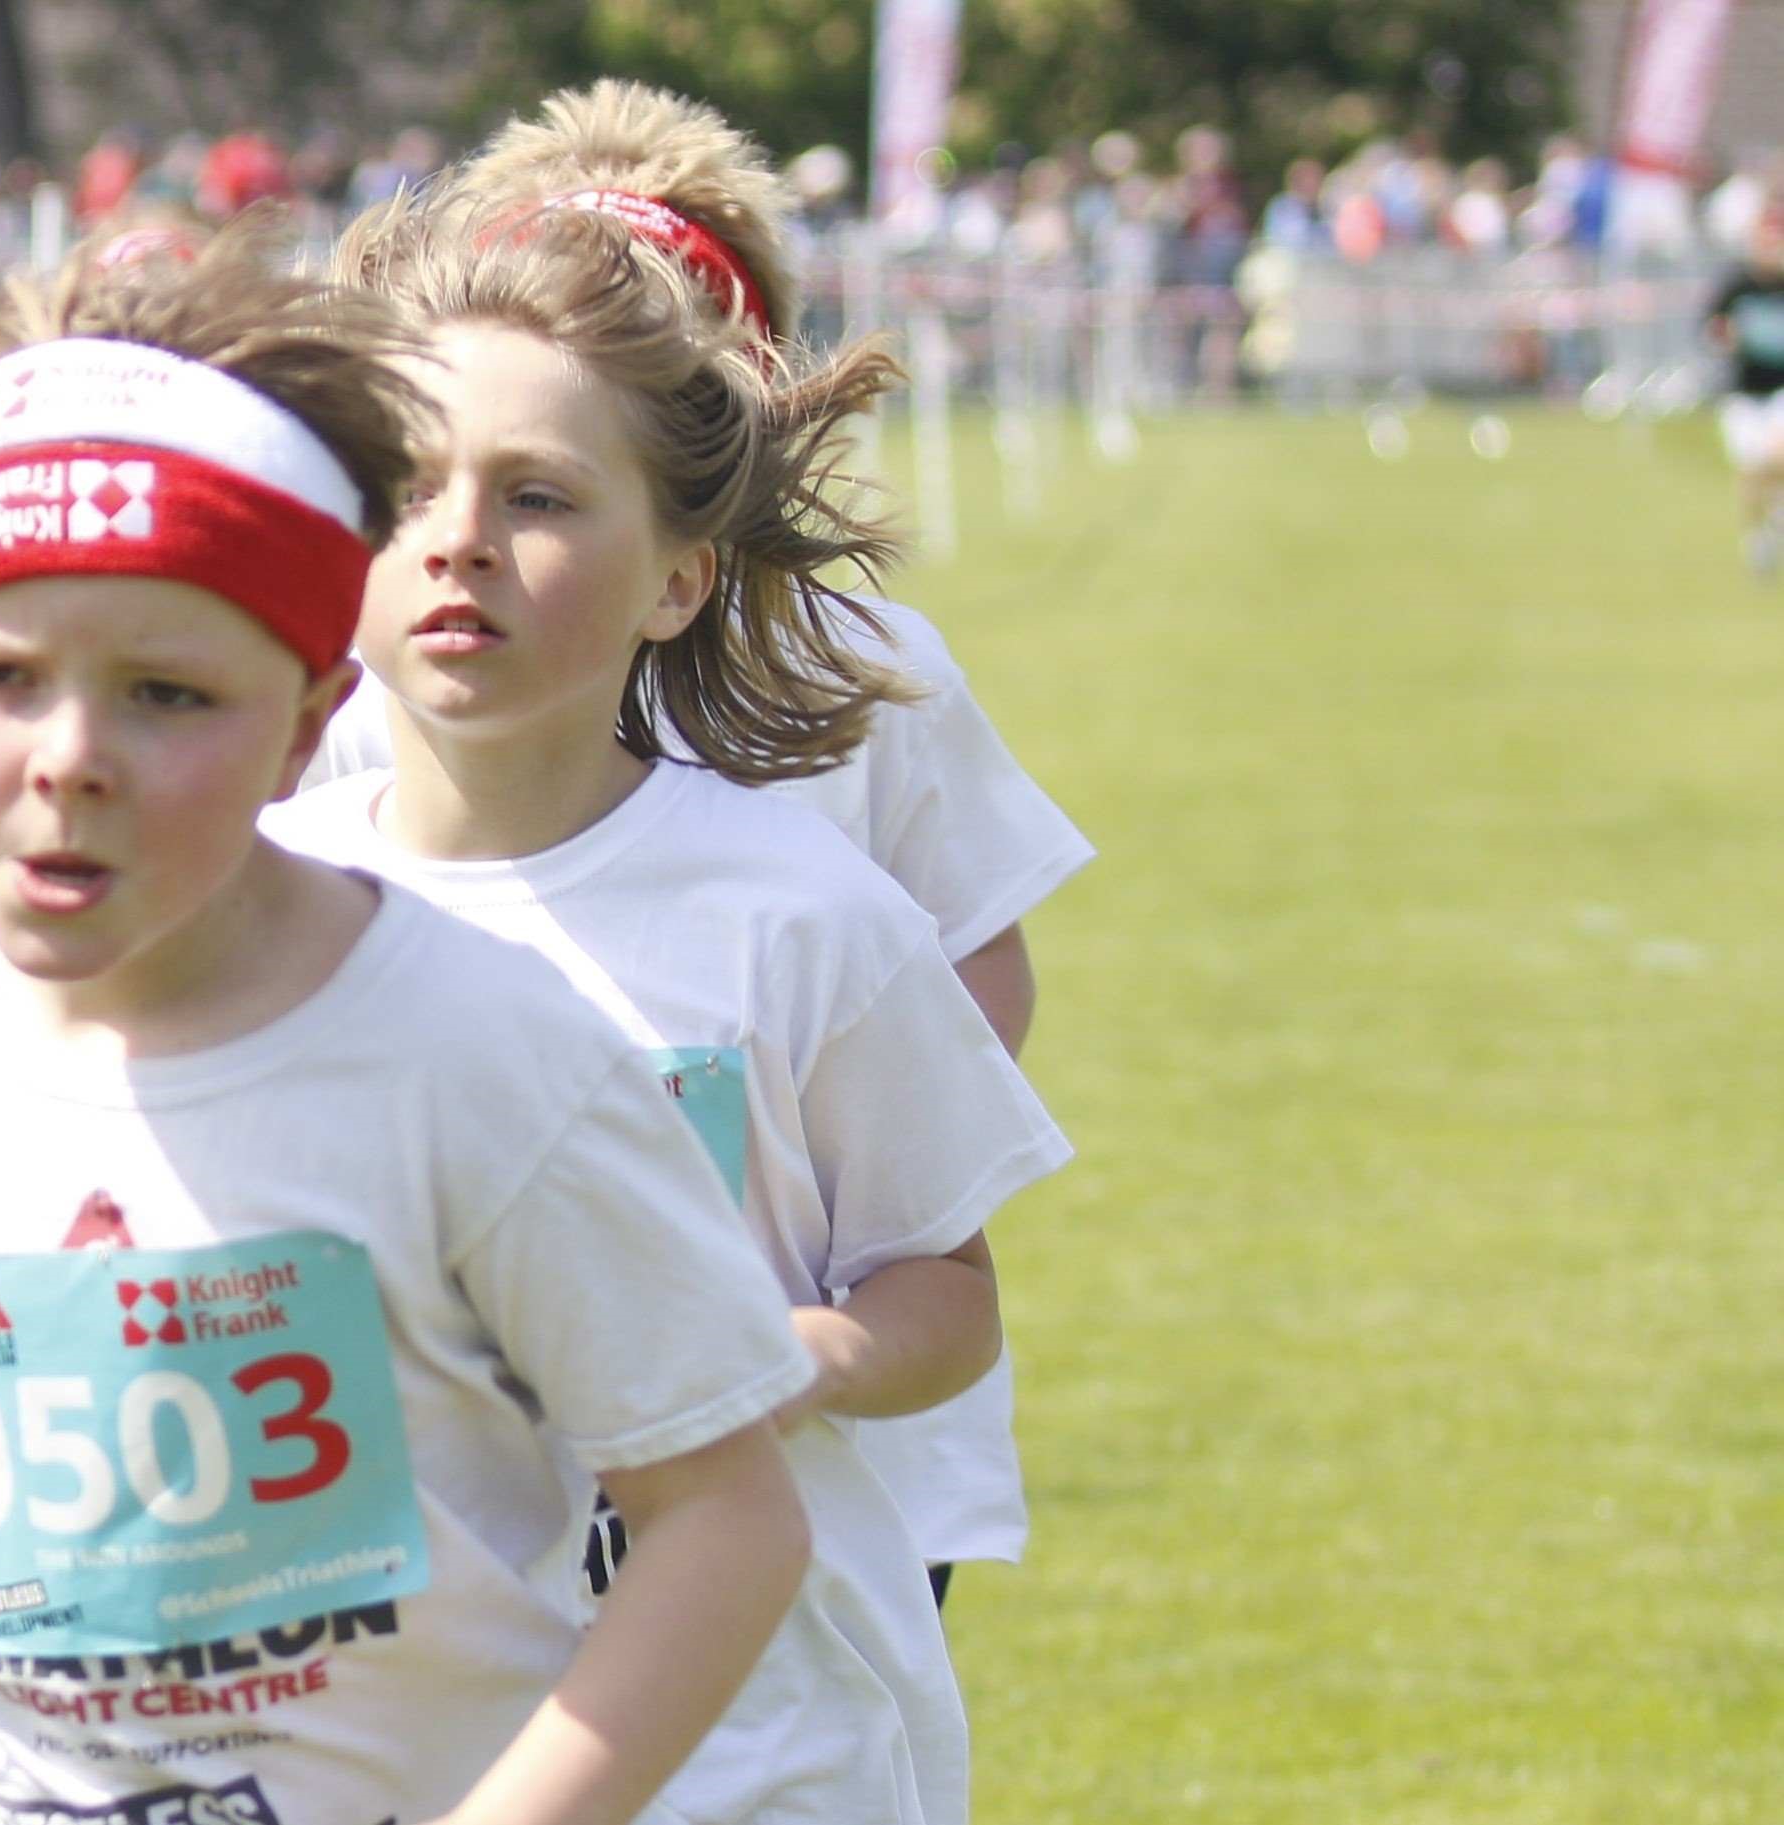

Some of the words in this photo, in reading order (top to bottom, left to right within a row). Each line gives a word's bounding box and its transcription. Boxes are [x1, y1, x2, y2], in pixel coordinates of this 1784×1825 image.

[187, 1260, 300, 1305] Knight
[193, 1301, 289, 1342] Frank
[132, 1654, 330, 1719] CENTRE
